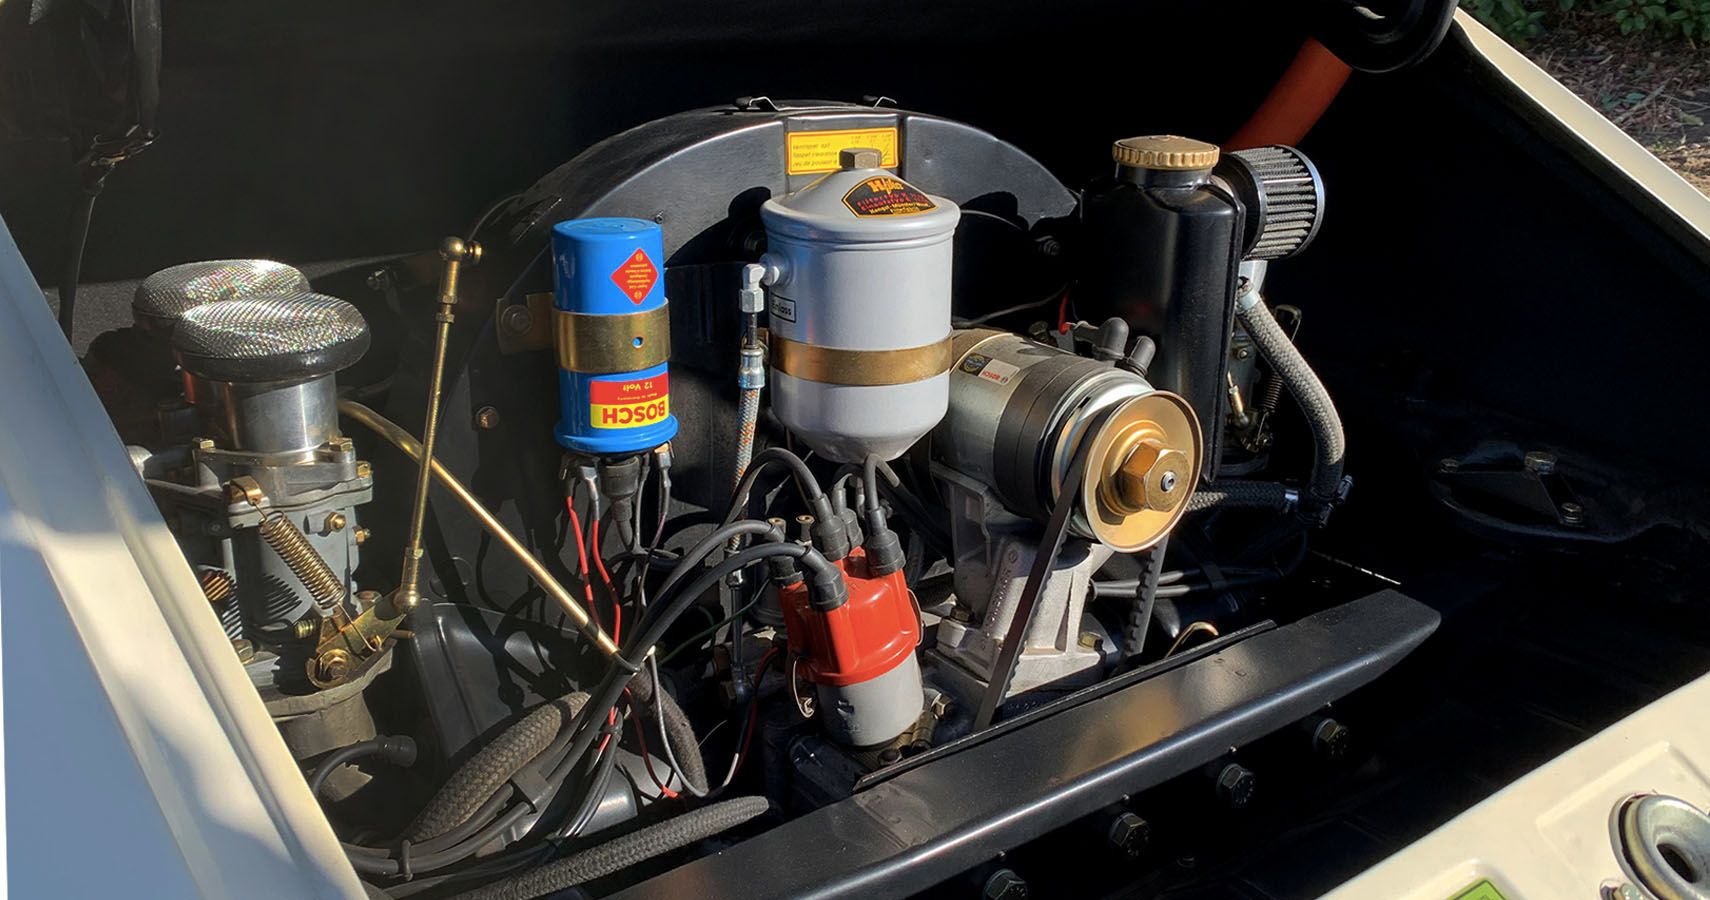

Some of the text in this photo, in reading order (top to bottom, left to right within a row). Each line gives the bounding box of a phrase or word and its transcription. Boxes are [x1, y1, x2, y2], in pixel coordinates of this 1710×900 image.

[622, 381, 653, 392] 12 Volt
[602, 401, 665, 424] BOSCH
